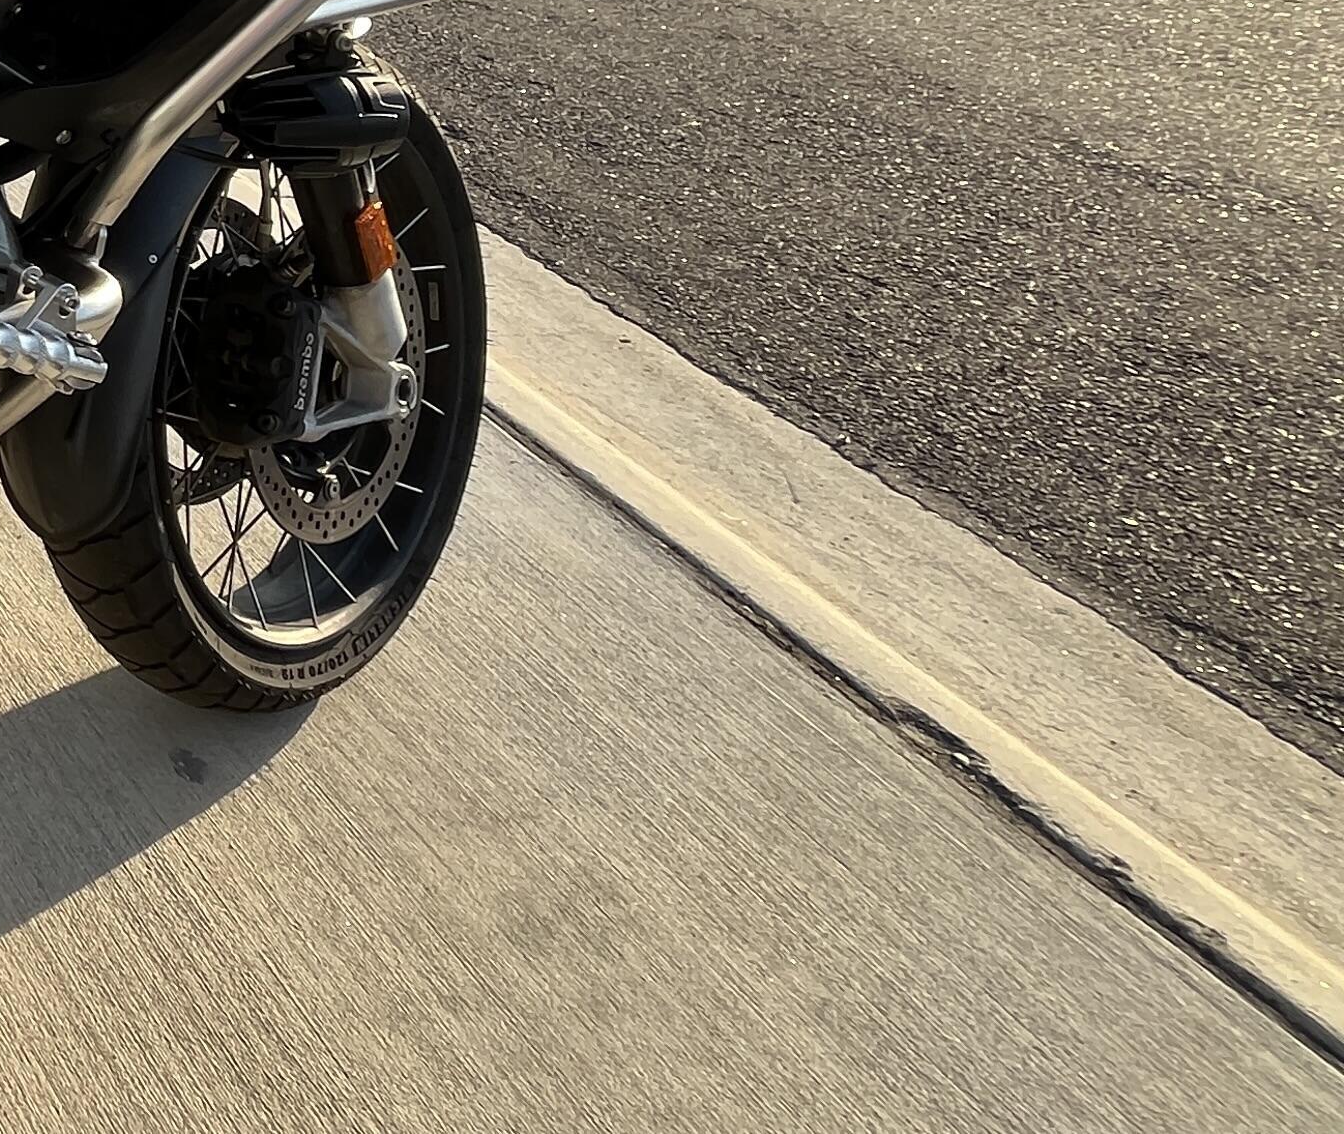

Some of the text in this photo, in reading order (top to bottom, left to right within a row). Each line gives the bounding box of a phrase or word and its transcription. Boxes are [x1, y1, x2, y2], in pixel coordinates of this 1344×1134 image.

[294, 333, 314, 410] brembo
[297, 667, 305, 680] R
[308, 649, 349, 677] 120/70
